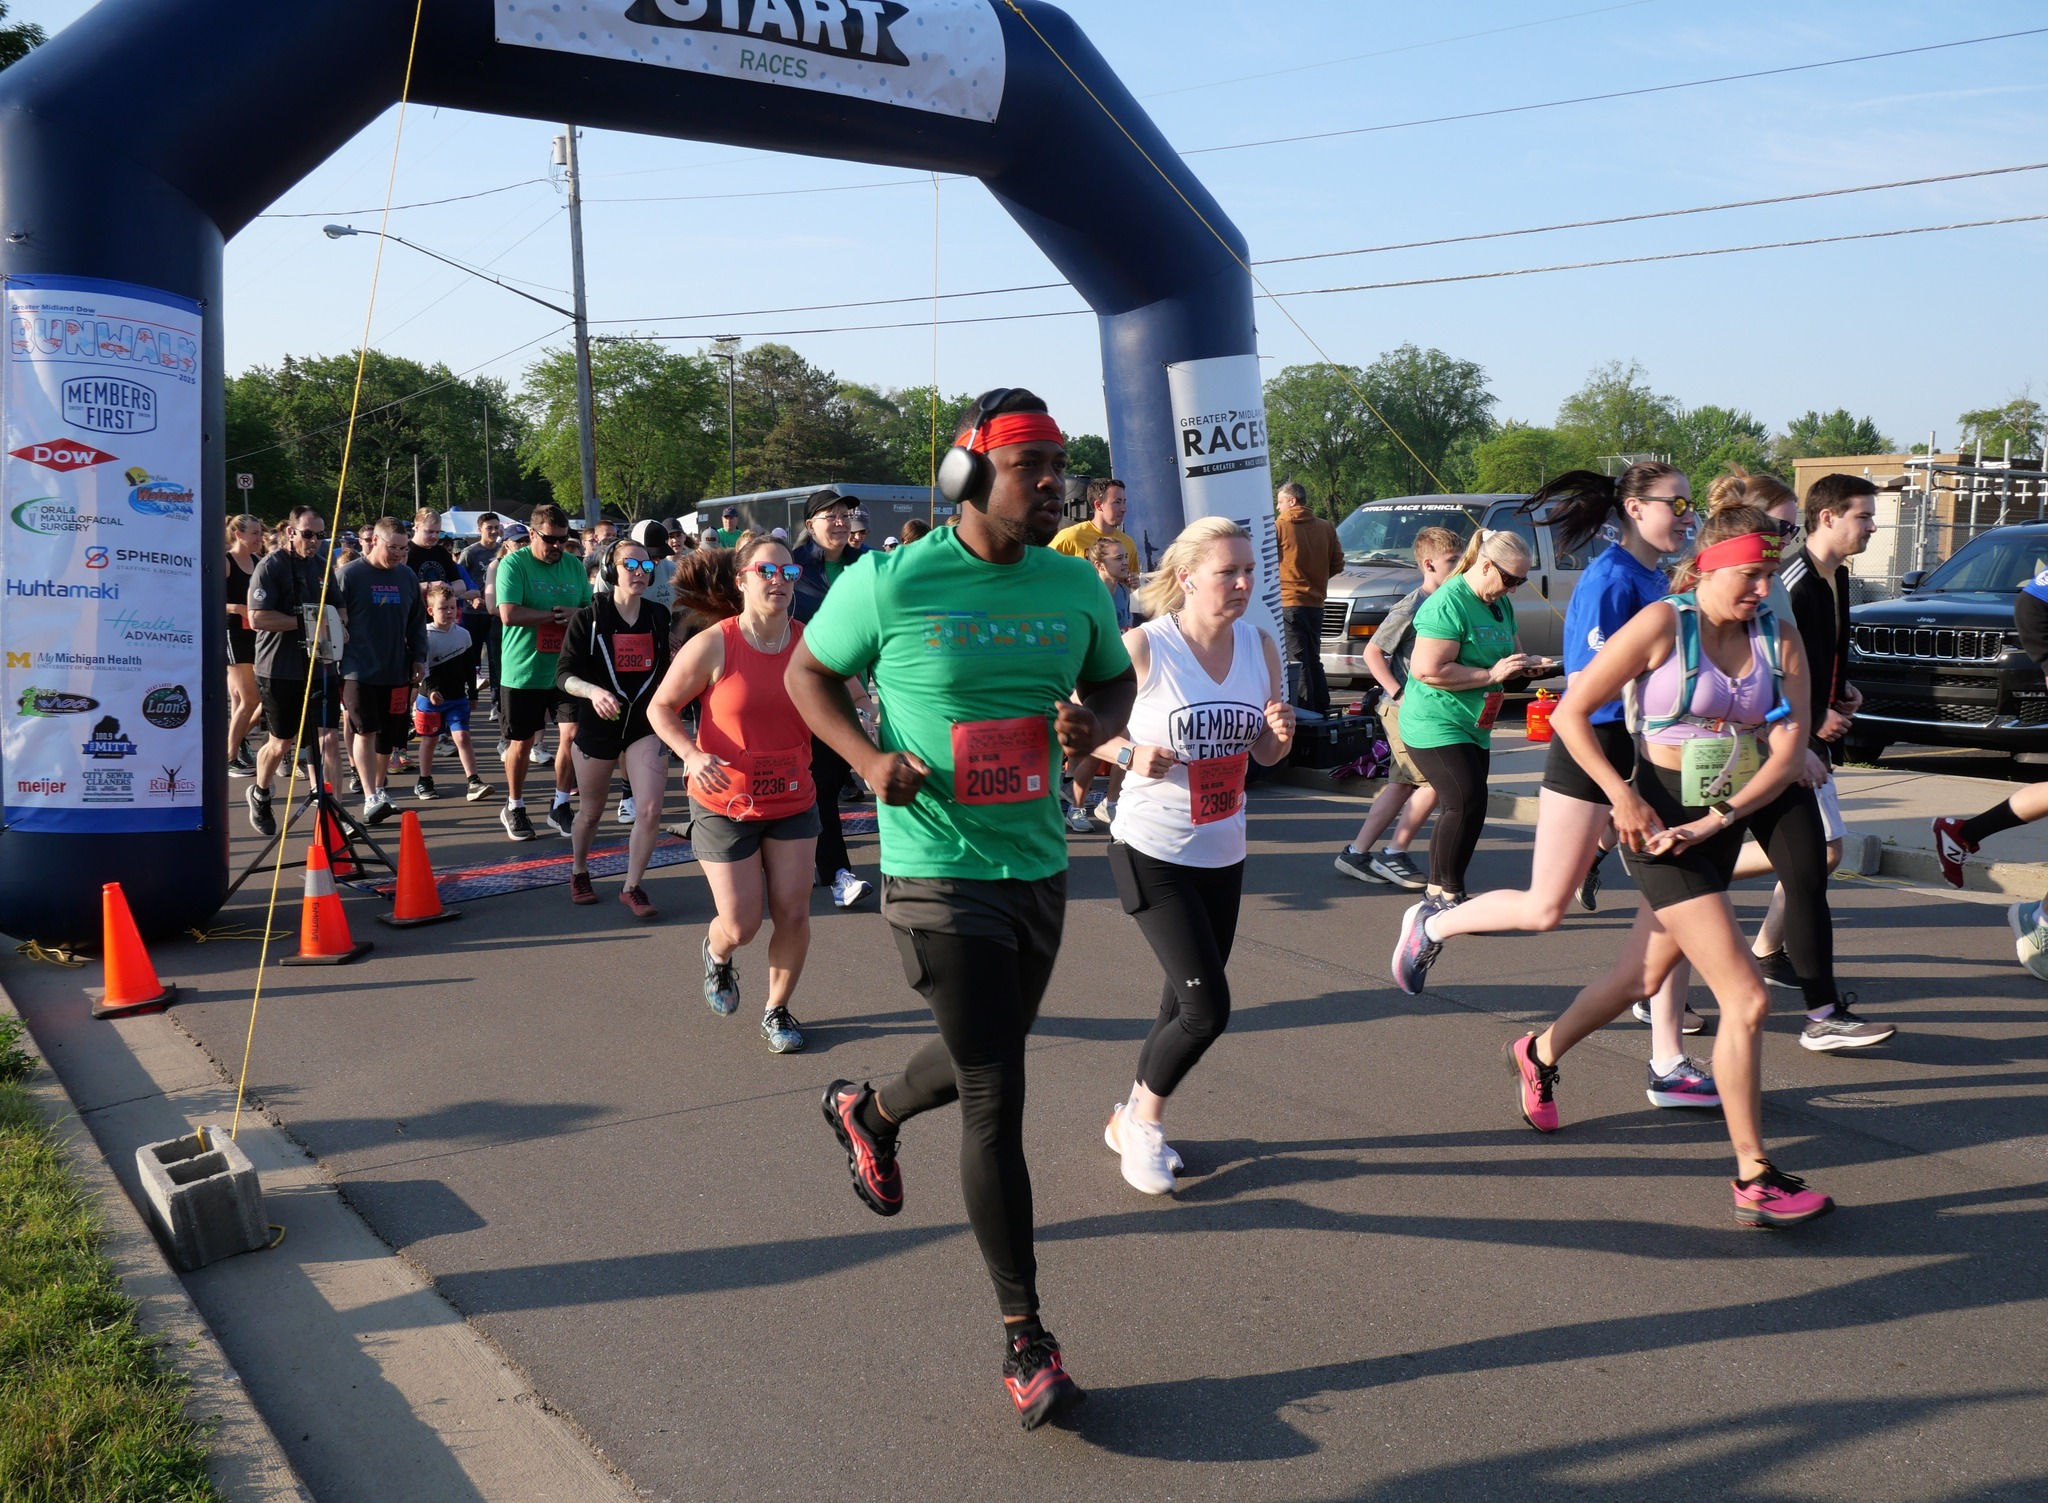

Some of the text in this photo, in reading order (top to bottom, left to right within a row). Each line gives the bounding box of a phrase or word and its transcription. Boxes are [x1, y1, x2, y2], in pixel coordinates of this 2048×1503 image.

[740, 49, 808, 79] RACES
[42, 304, 75, 312] Midland
[11, 317, 197, 375] RUNWALK
[179, 374, 196, 385] 2025
[68, 382, 151, 411] MEMBERS
[87, 406, 135, 430] FIRST
[1180, 413, 1228, 428] GREATER
[1183, 419, 1266, 458] RACES
[1203, 465, 1211, 473] BE
[1212, 463, 1236, 472] GREATER
[137, 487, 194, 504] Waterpark
[1361, 505, 1394, 513] OFFICIAL
[41, 514, 124, 526] MAXILLOFACIAL
[175, 512, 190, 521] Hotel
[41, 523, 90, 532] SURGERY
[116, 549, 193, 568] SPHERION
[1761, 548, 1780, 558] MO
[6, 579, 119, 600] Huhtamaki
[104, 608, 191, 637] Health
[125, 631, 194, 644] ADVANTAGE
[38, 652, 142, 666] My Michigan Health
[618, 654, 643, 668] 2392
[1177, 708, 1263, 741] MEMBERS
[95, 732, 113, 741] 100.9
[95, 742, 130, 752] MITT
[982, 753, 1000, 762] RUN
[82, 771, 134, 779] CITY SEWER
[86, 778, 131, 786] CLEANERS
[967, 765, 1022, 797] 2095
[18, 777, 67, 796] meijer
[752, 777, 786, 796] 2236
[1211, 781, 1224, 789] RUN
[1700, 774, 1733, 799] 55
[1201, 788, 1237, 817] 2396
